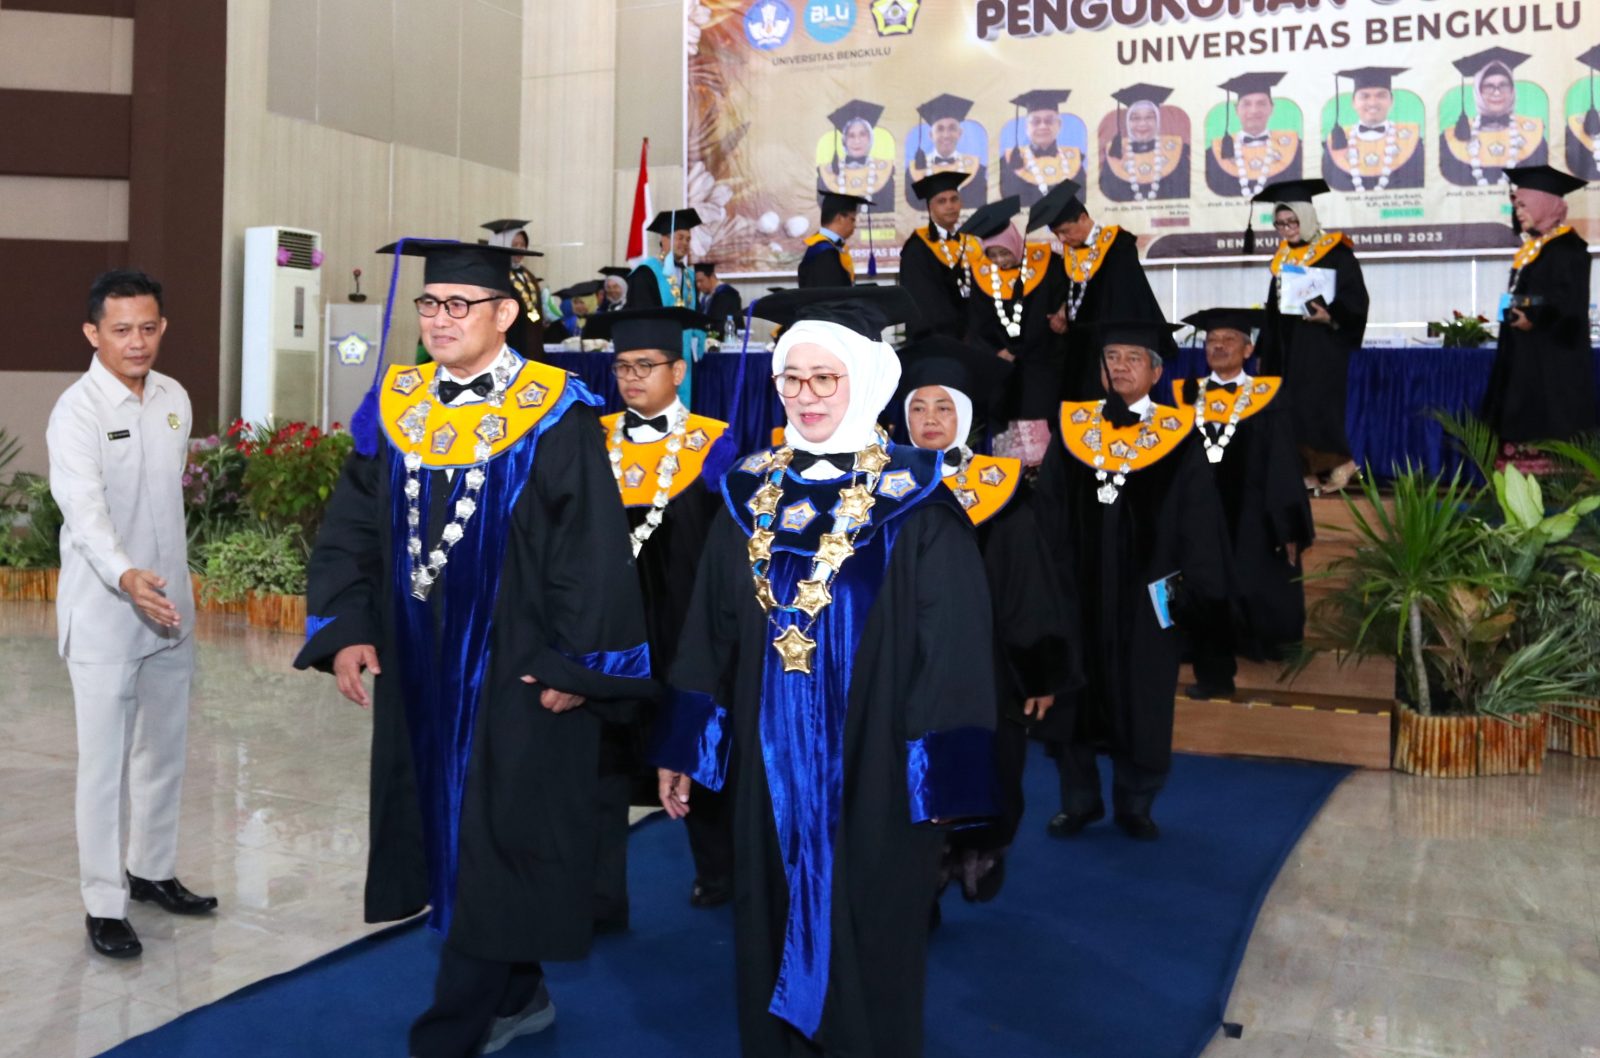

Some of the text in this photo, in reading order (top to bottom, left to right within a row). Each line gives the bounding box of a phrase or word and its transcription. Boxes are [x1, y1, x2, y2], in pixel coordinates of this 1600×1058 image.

[811, 4, 849, 23] BLU
[1117, 1, 1581, 65] UNIVERSITAS BENGKULU
[772, 47, 891, 65] UNIVERSITAS BENGKULU
[1346, 232, 1403, 244] EMBER
[1408, 231, 1443, 243] 2023
